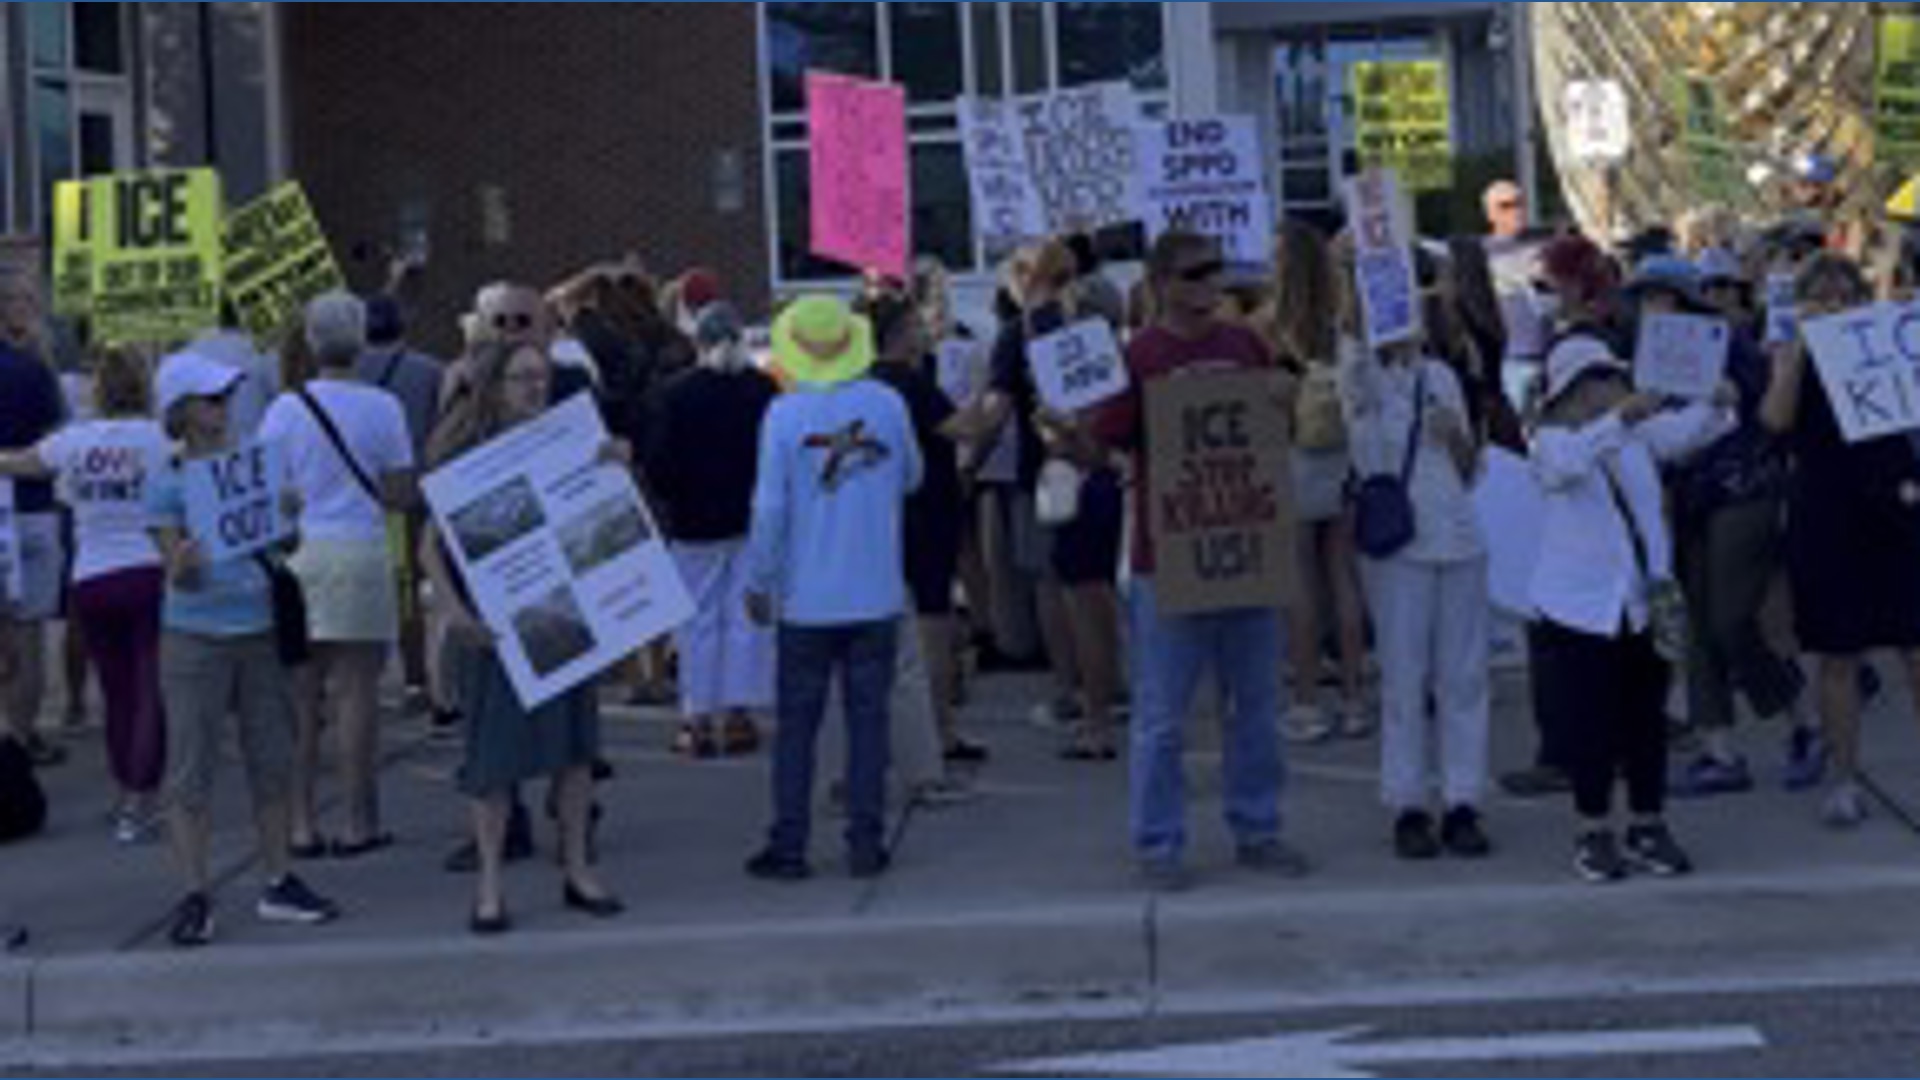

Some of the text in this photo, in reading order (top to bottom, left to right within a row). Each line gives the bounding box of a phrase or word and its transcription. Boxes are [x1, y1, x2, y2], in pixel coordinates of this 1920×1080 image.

[1167, 119, 1226, 148] END
[116, 172, 189, 249] ICE
[1845, 368, 1920, 430] KI
[1181, 401, 1251, 454] ICE
[211, 445, 267, 502] ICE
[217, 498, 275, 548] OUT
